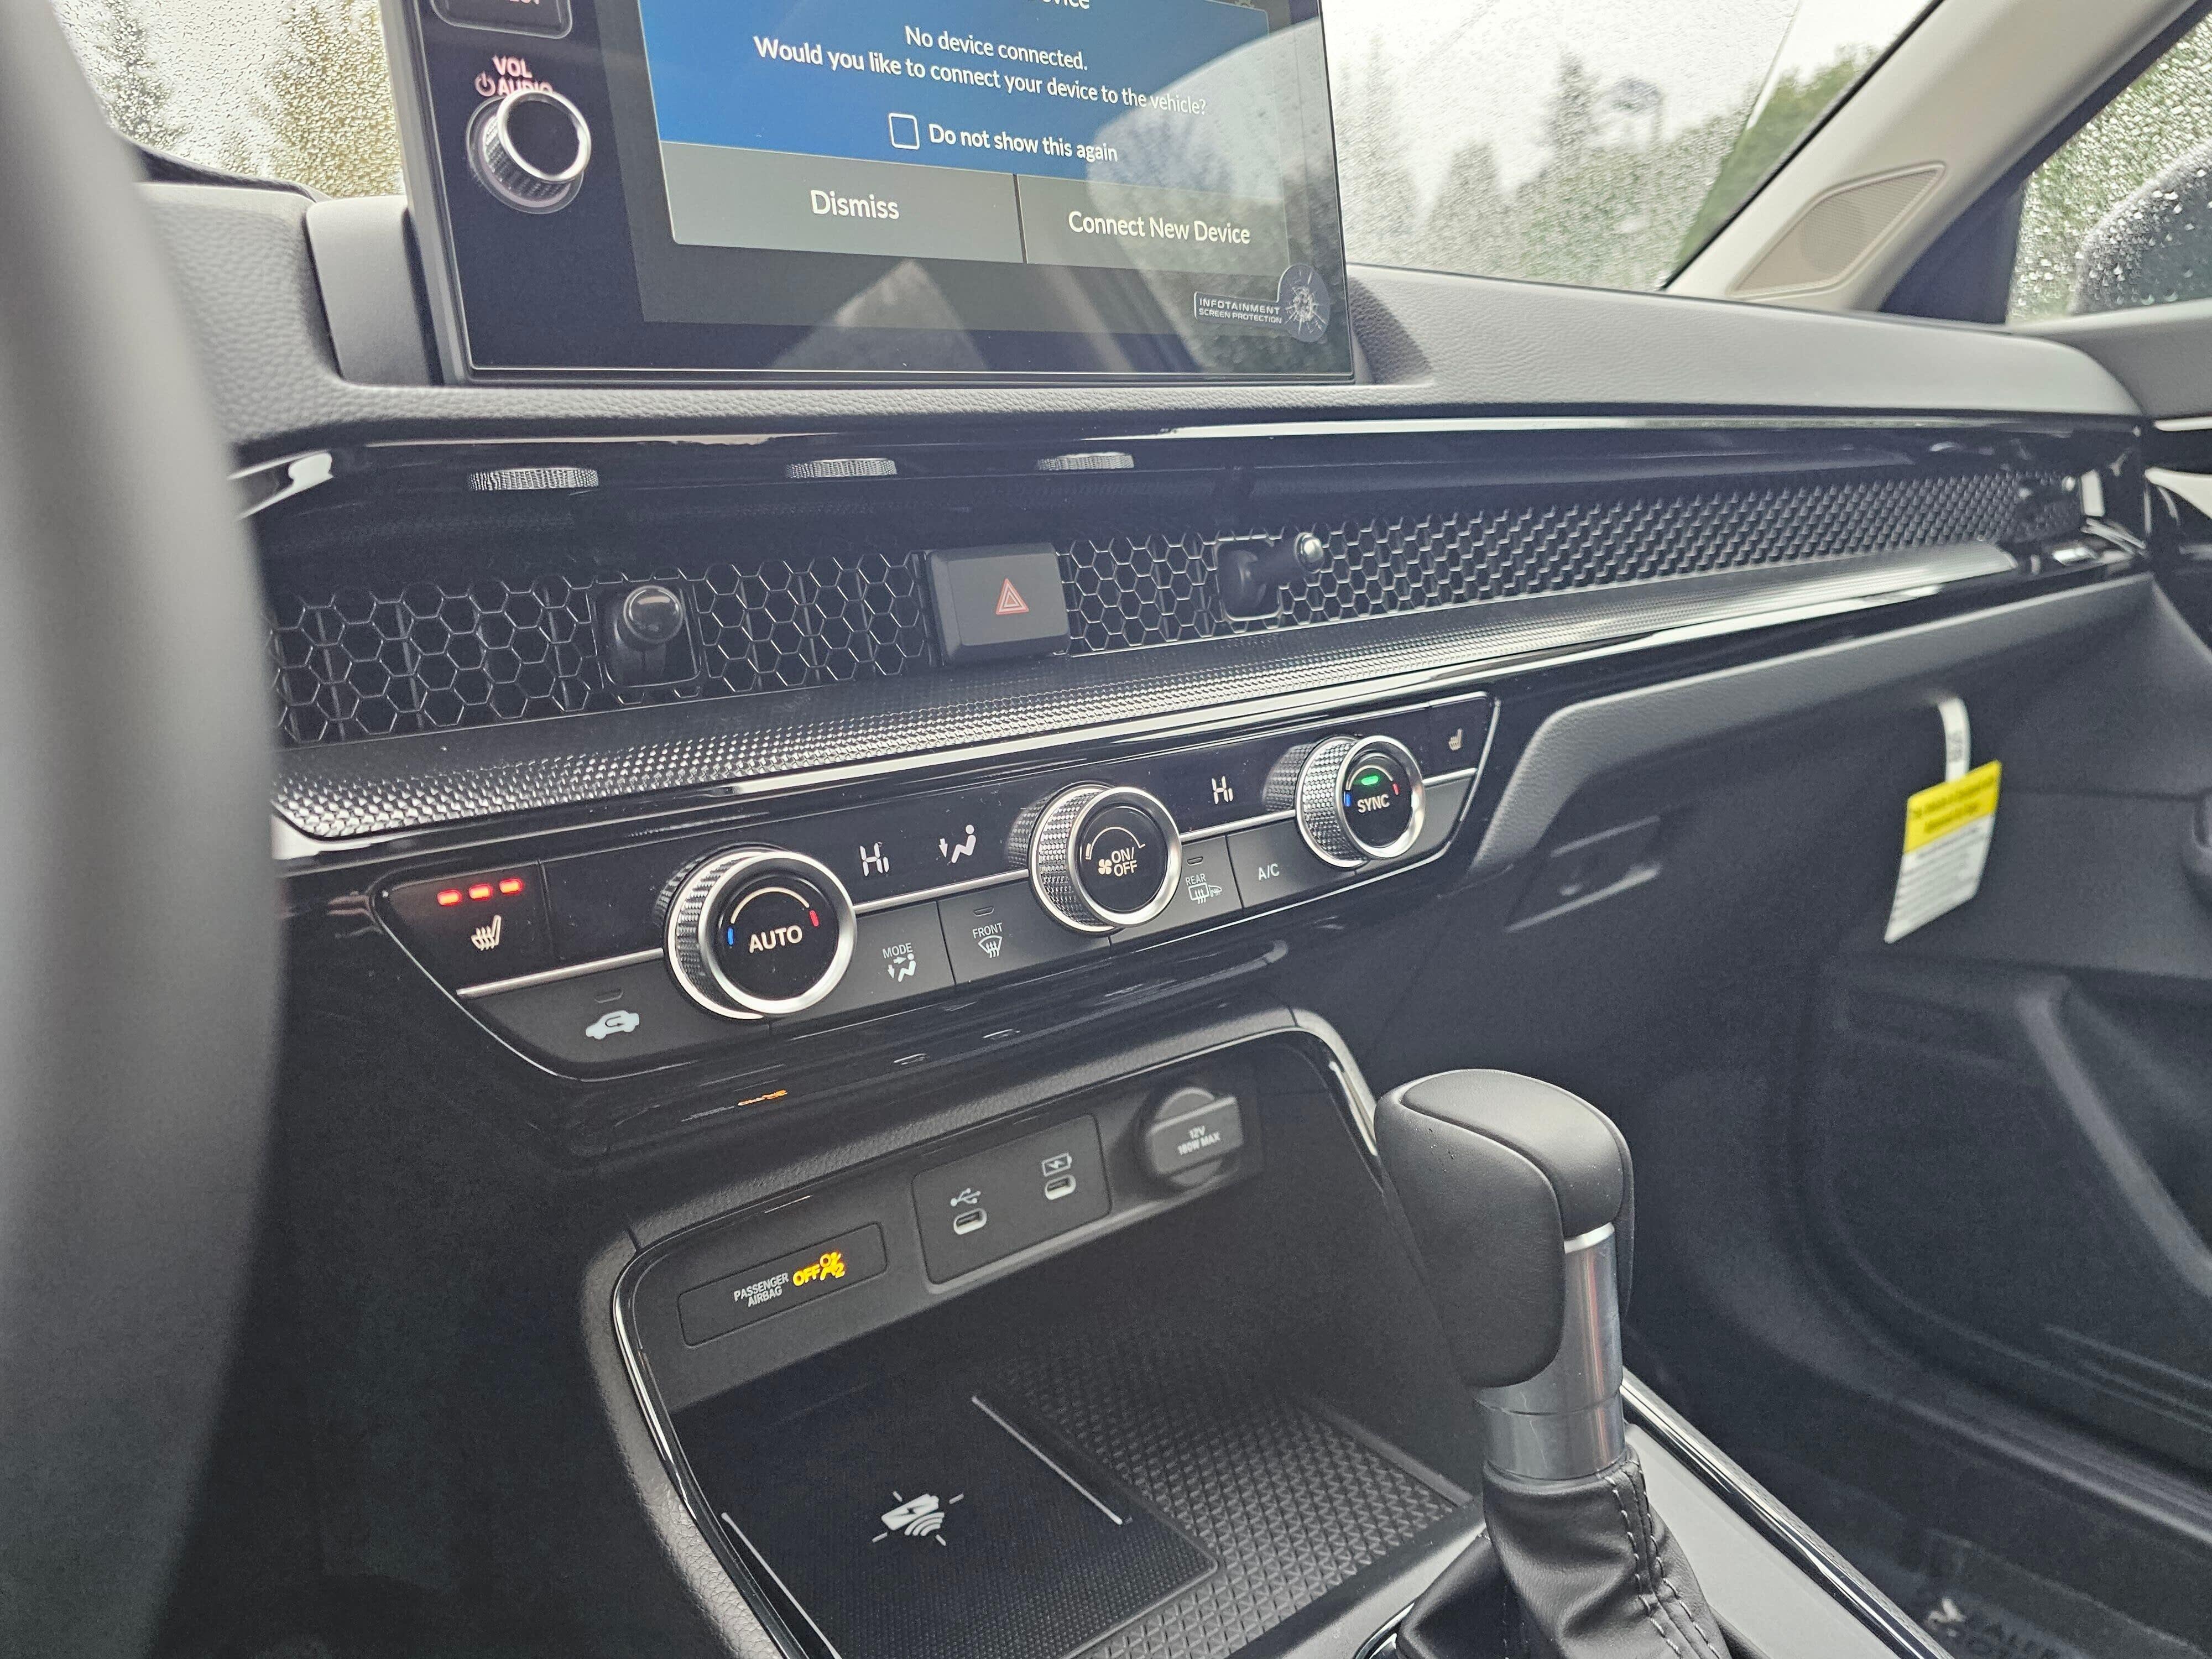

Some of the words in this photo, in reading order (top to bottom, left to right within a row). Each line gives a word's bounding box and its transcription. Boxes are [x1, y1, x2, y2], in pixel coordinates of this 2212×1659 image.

[904, 25, 933, 48] No
[938, 31, 994, 56] device
[998, 44, 1088, 71] connected.
[492, 55, 533, 78] VOL
[753, 36, 823, 65] Would
[827, 51, 864, 71] you
[869, 51, 902, 75] like
[905, 58, 926, 78] to
[931, 65, 1001, 88] connect
[1004, 75, 1043, 93] your
[1047, 77, 1098, 101] device
[1101, 86, 1118, 104] to
[1121, 87, 1147, 107] the
[1150, 93, 1207, 115] vehicle?
[929, 123, 956, 144] Do
[960, 130, 990, 148] not
[994, 131, 1039, 154] show
[1042, 137, 1073, 157] this
[1076, 143, 1119, 163] again
[810, 189, 900, 220] Dismiss
[1068, 211, 1146, 237] Connect
[1149, 216, 1189, 240] New
[1193, 221, 1251, 244] Device
[1199, 298, 1280, 315] INFOTAINMENT
[1199, 308, 1231, 319] SCREEN
[1232, 311, 1282, 324] PROTECTION
[1357, 794, 1390, 814] SYNC
[1111, 847, 1134, 863] ON/
[1114, 860, 1138, 877] OFF
[1258, 863, 1280, 881] A/C
[1185, 873, 1207, 886] REAR
[749, 925, 802, 953] AUTO
[972, 922, 1003, 939] FRONT
[882, 942, 914, 959] MODE
[1189, 1125, 1206, 1139] 12V
[1201, 1131, 1222, 1147] MAX
[792, 1264, 821, 1286] OFF
[733, 1272, 789, 1302] PASSENGER
[748, 1286, 783, 1308] AIRBAG
